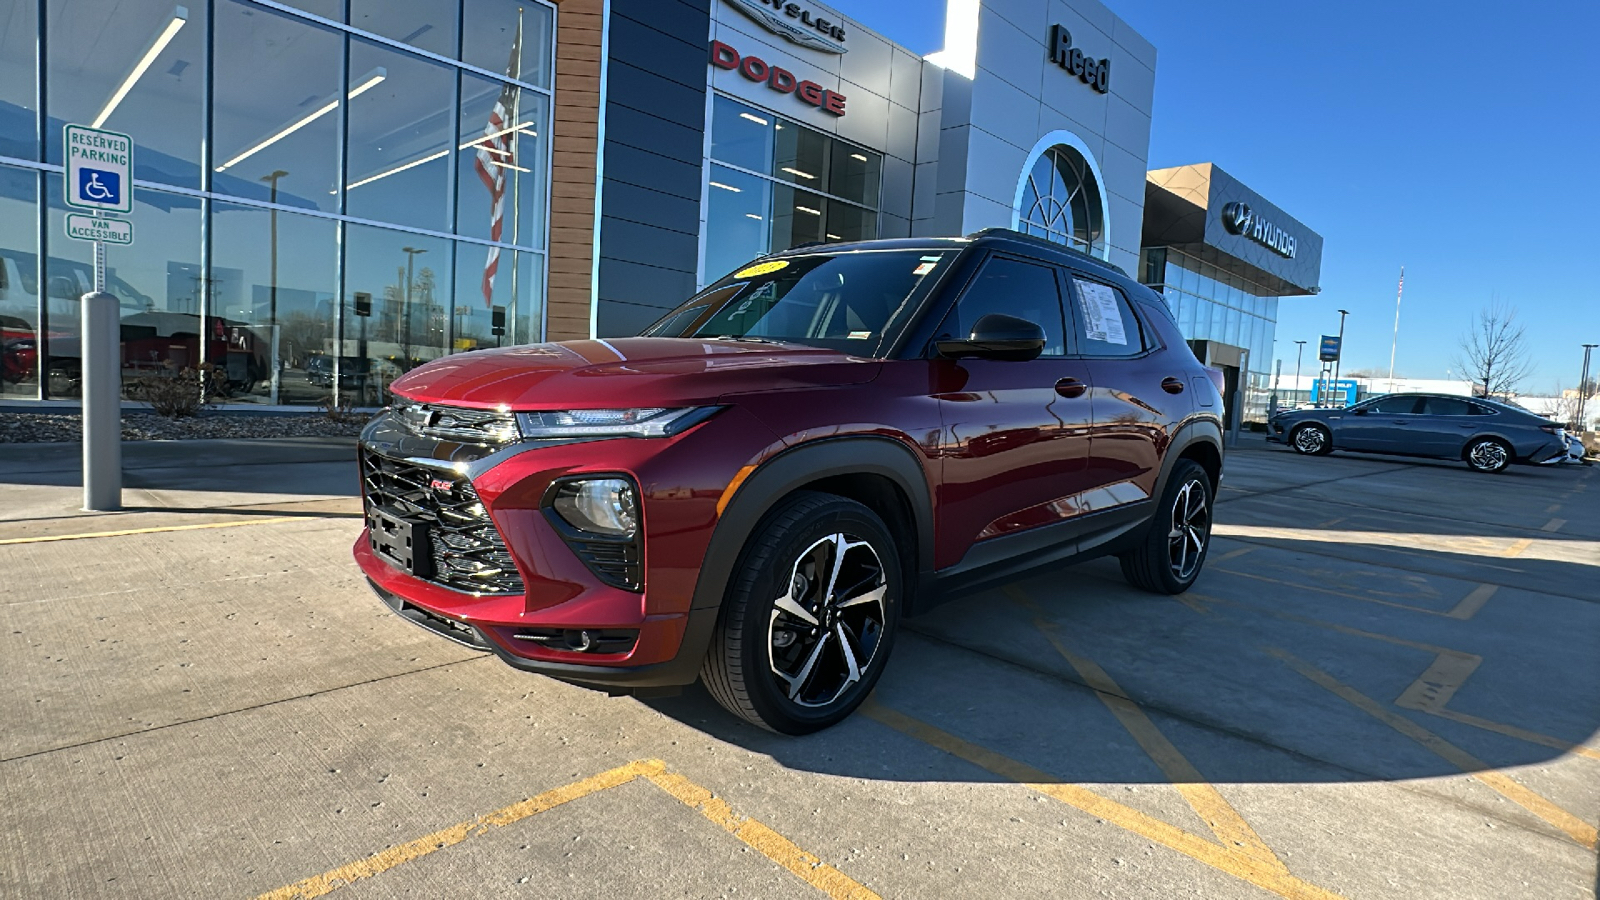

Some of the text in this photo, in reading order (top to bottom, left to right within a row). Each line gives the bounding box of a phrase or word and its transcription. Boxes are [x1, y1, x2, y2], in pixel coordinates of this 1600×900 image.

[761, 0, 845, 42] YSLER
[1049, 23, 1110, 94] Reed
[709, 40, 847, 117] DODGE
[71, 146, 127, 166] PARKING
[72, 132, 126, 152] RESERVED
[71, 226, 129, 241] ACCESSIBLE
[91, 219, 110, 229] VAN
[1253, 214, 1298, 259] HYUNDAI
